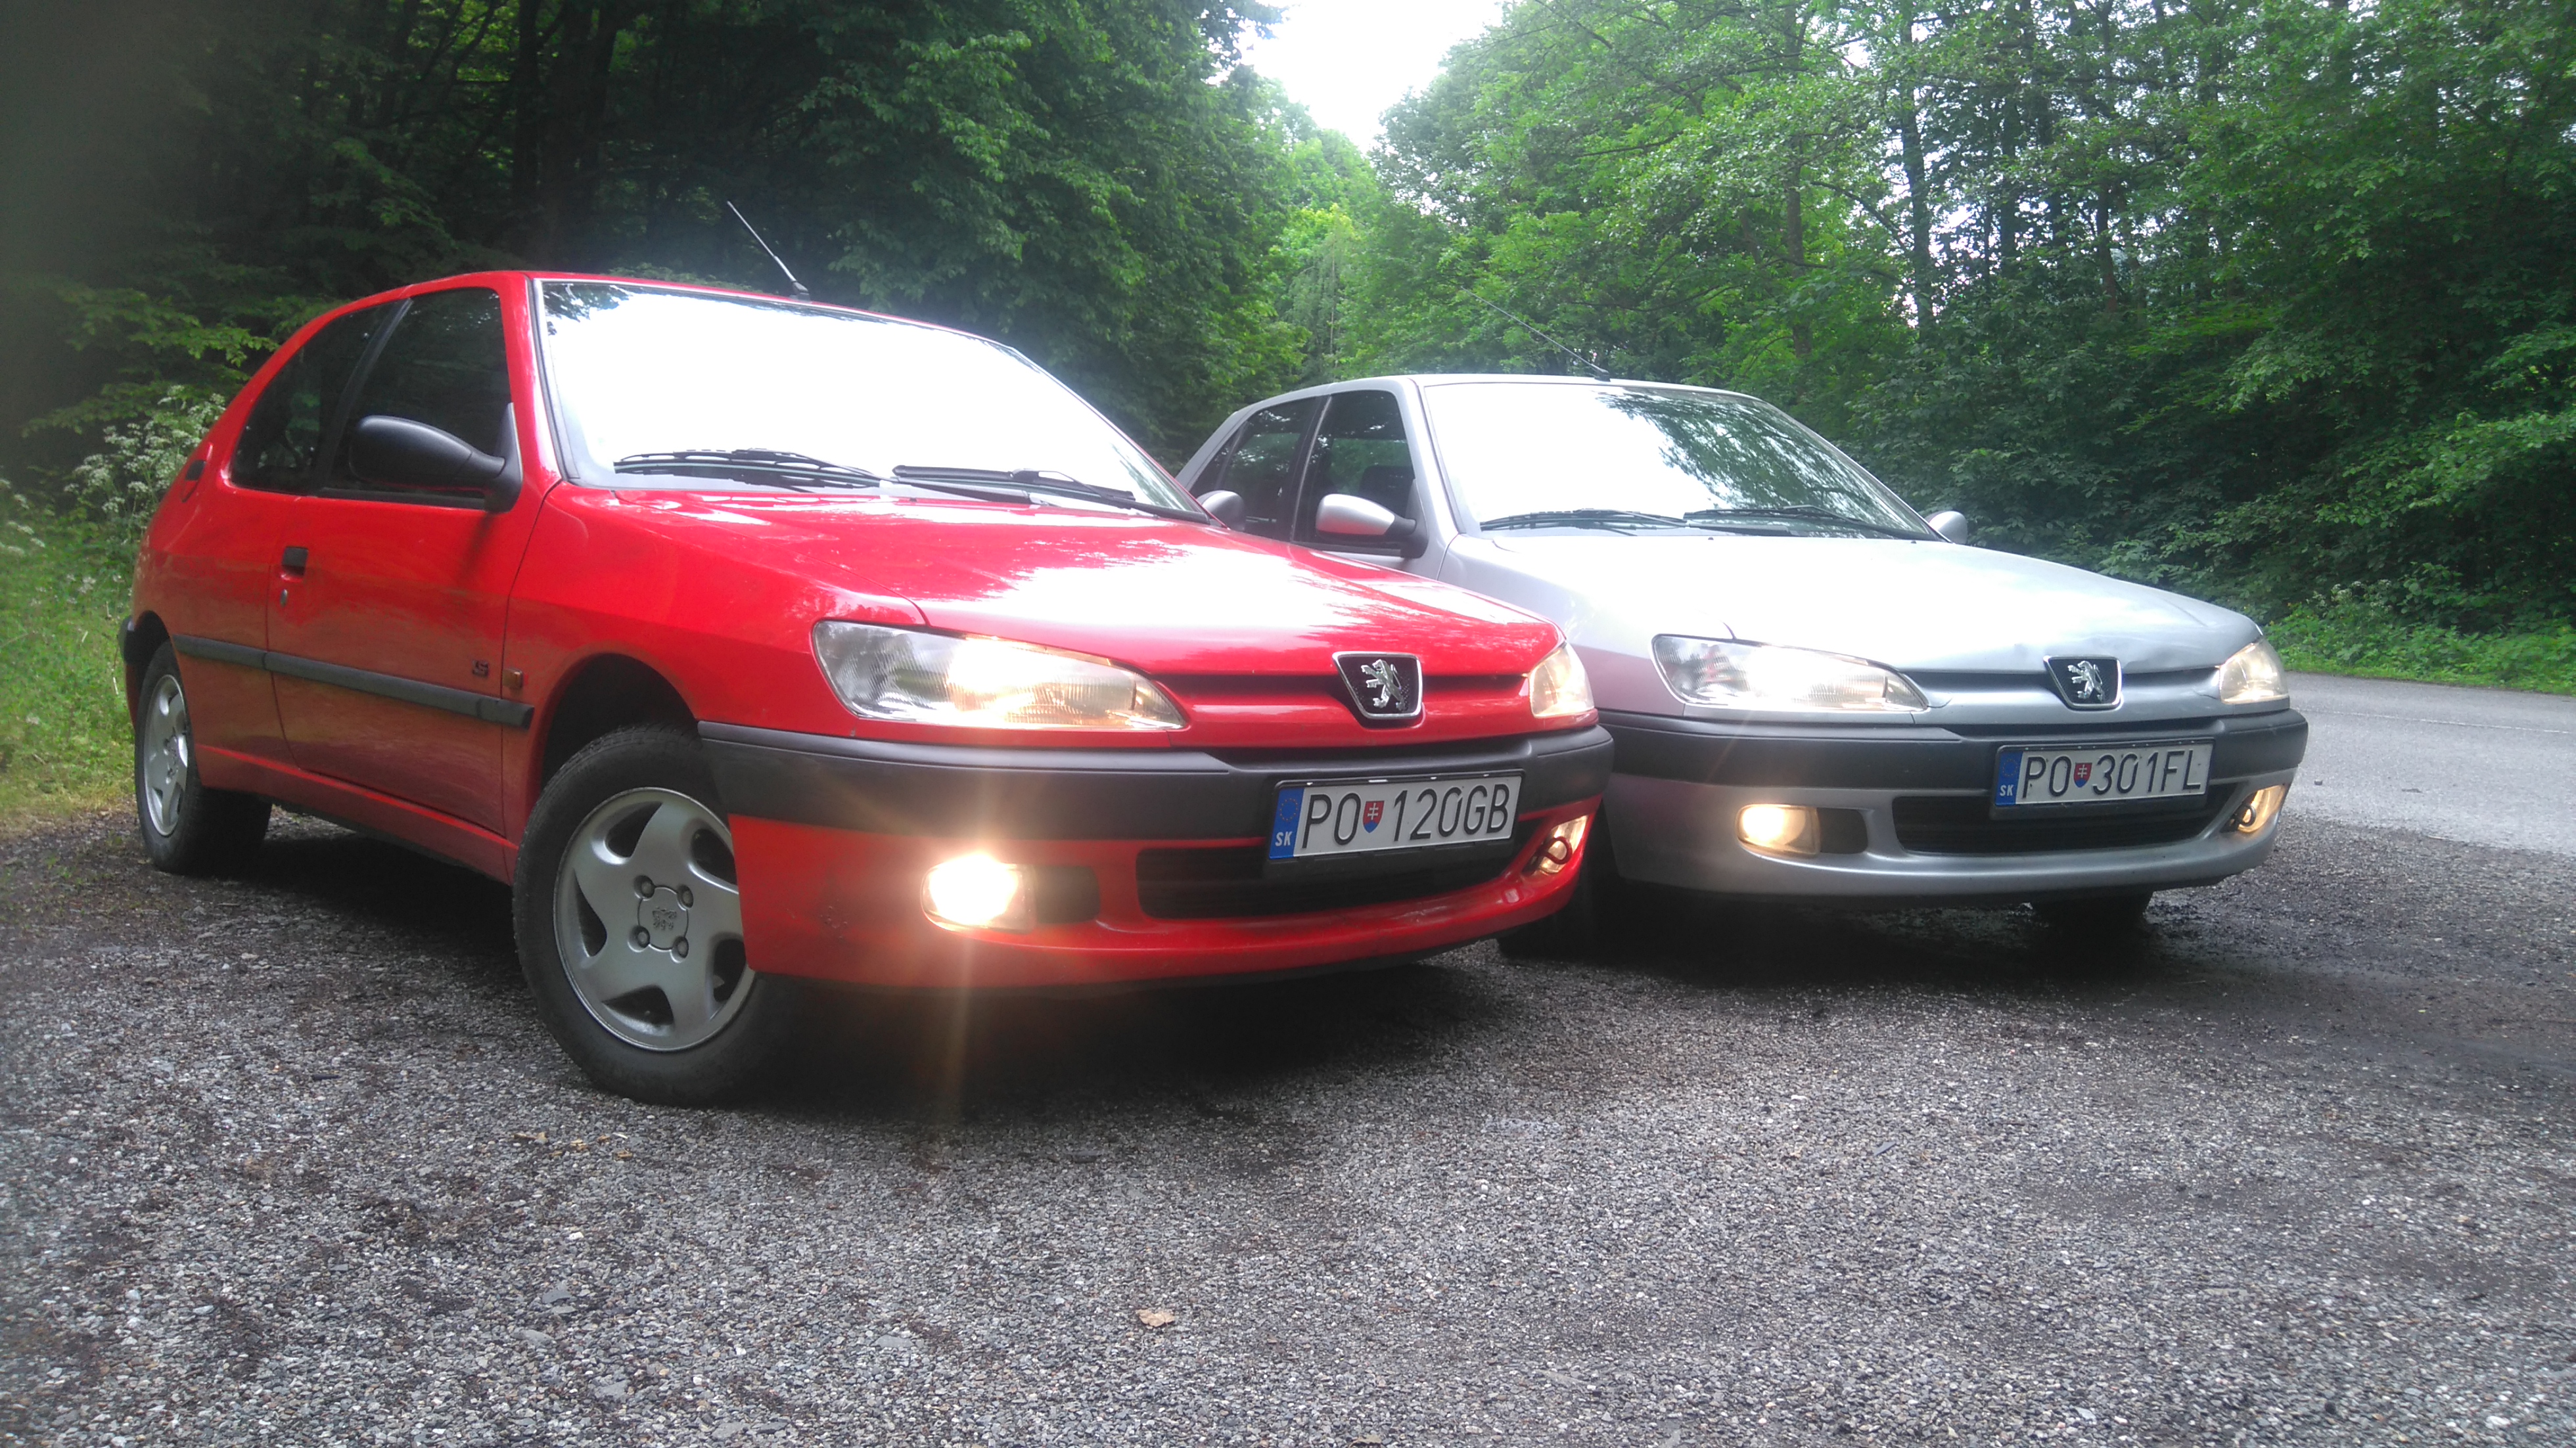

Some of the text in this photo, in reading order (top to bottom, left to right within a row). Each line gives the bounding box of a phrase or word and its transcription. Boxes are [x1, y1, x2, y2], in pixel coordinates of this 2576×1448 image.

[1999, 784, 2014, 797] SK
[2022, 750, 2201, 799] PO 301FL
[1301, 783, 1510, 849] PO 120GB
[1275, 830, 1293, 847] SK
